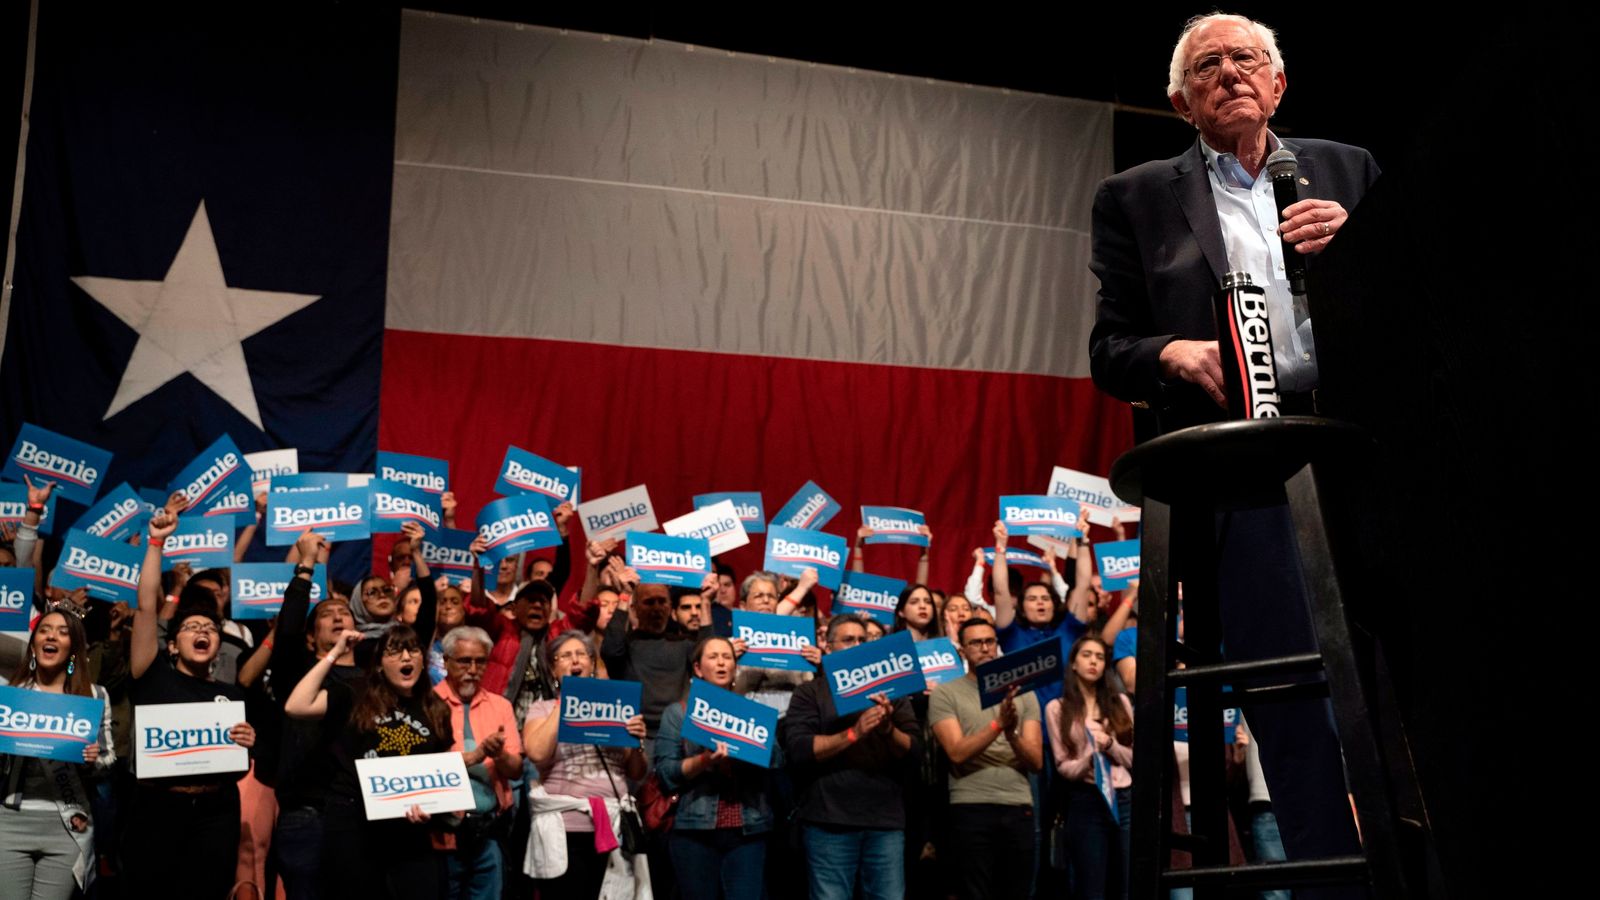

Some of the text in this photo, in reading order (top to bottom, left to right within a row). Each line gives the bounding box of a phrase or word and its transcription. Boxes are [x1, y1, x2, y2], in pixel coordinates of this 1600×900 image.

[17, 441, 97, 484] Bernie
[251, 464, 292, 482] rnie
[505, 460, 569, 498] Bernie
[1054, 482, 1112, 509] Bernie
[87, 498, 138, 537] ernie
[274, 502, 362, 525] Bernie
[375, 493, 440, 528] Bernie
[587, 501, 647, 531] Bernie
[1005, 506, 1076, 524] Bernie
[480, 509, 549, 541] Bernie
[163, 529, 228, 551] ernie
[772, 538, 840, 565] Bernie
[66, 547, 141, 584] Berni
[631, 545, 706, 570] Bernie
[238, 579, 321, 598] Bere
[839, 583, 898, 608] Bernie
[739, 626, 810, 649] Bernie
[832, 652, 913, 692] Bernie
[983, 652, 1057, 690] Bernie
[0, 705, 91, 736] Bernie
[565, 696, 634, 720] Bernie
[694, 697, 768, 743] Bernie
[395, 711, 430, 736] PASO
[369, 769, 461, 794] Bernie
